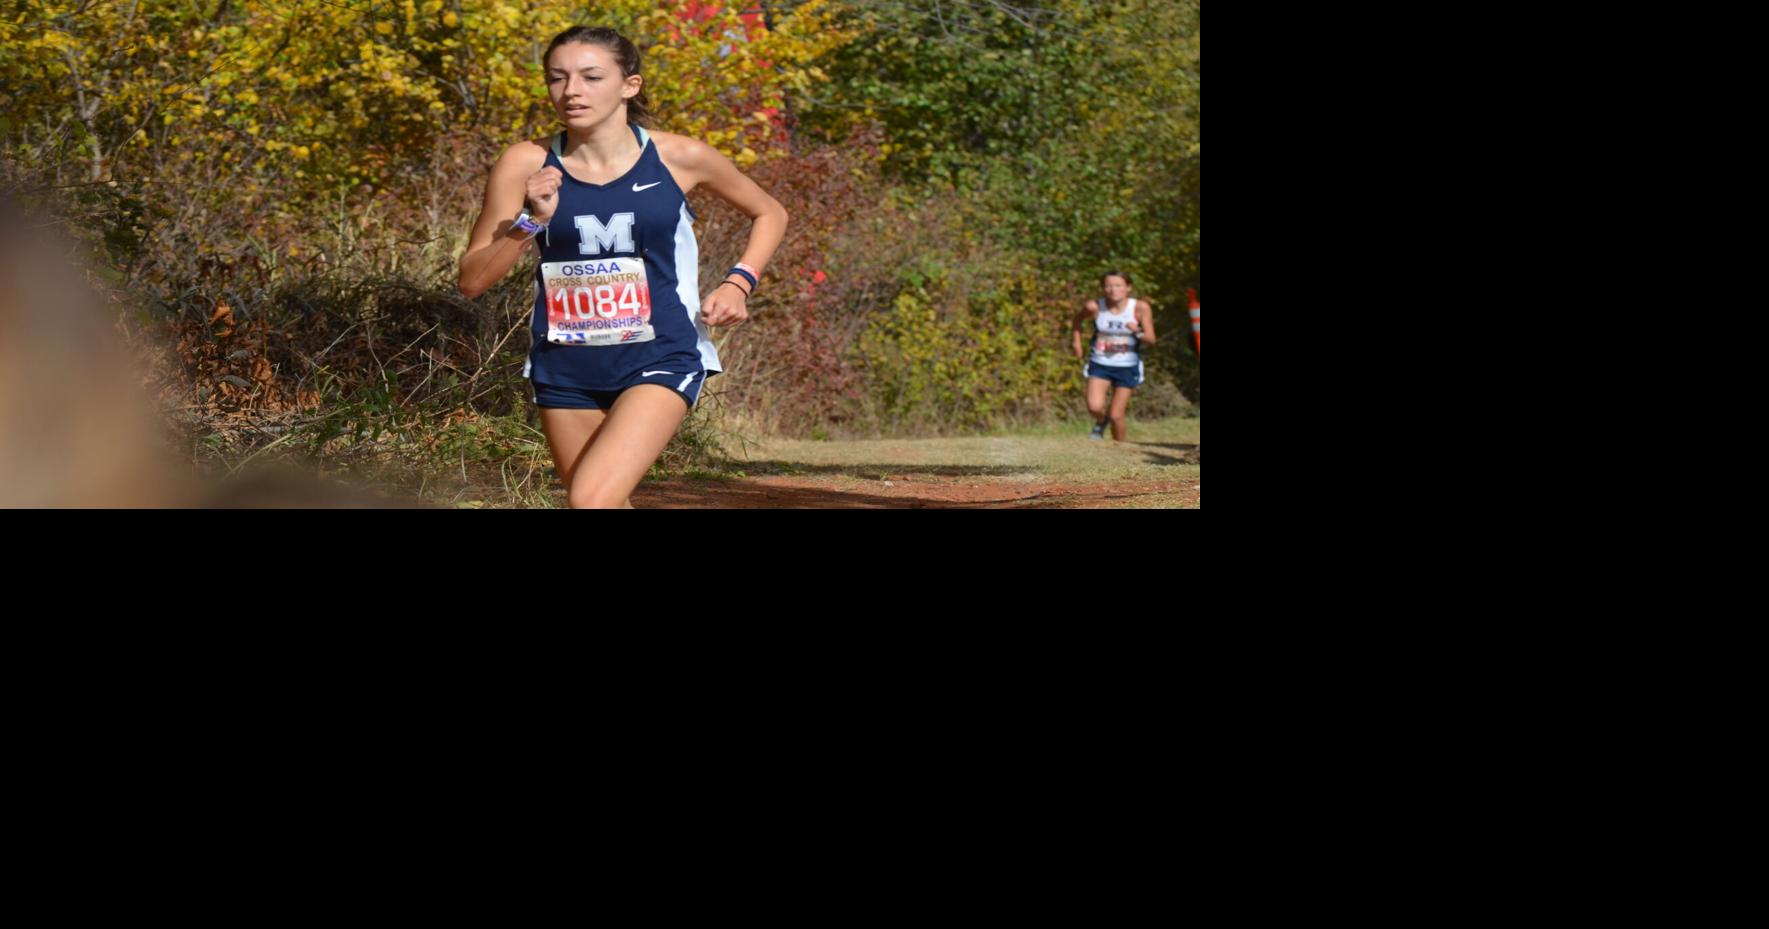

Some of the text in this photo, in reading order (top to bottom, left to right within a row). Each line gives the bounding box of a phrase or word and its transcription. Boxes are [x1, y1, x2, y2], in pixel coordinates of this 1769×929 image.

[573, 212, 635, 255] M
[562, 262, 621, 276] OSSAA
[549, 272, 640, 287] CROSS COUNTRY
[555, 283, 641, 320] 1084
[557, 317, 643, 331] CHAMPIONSHIPS
